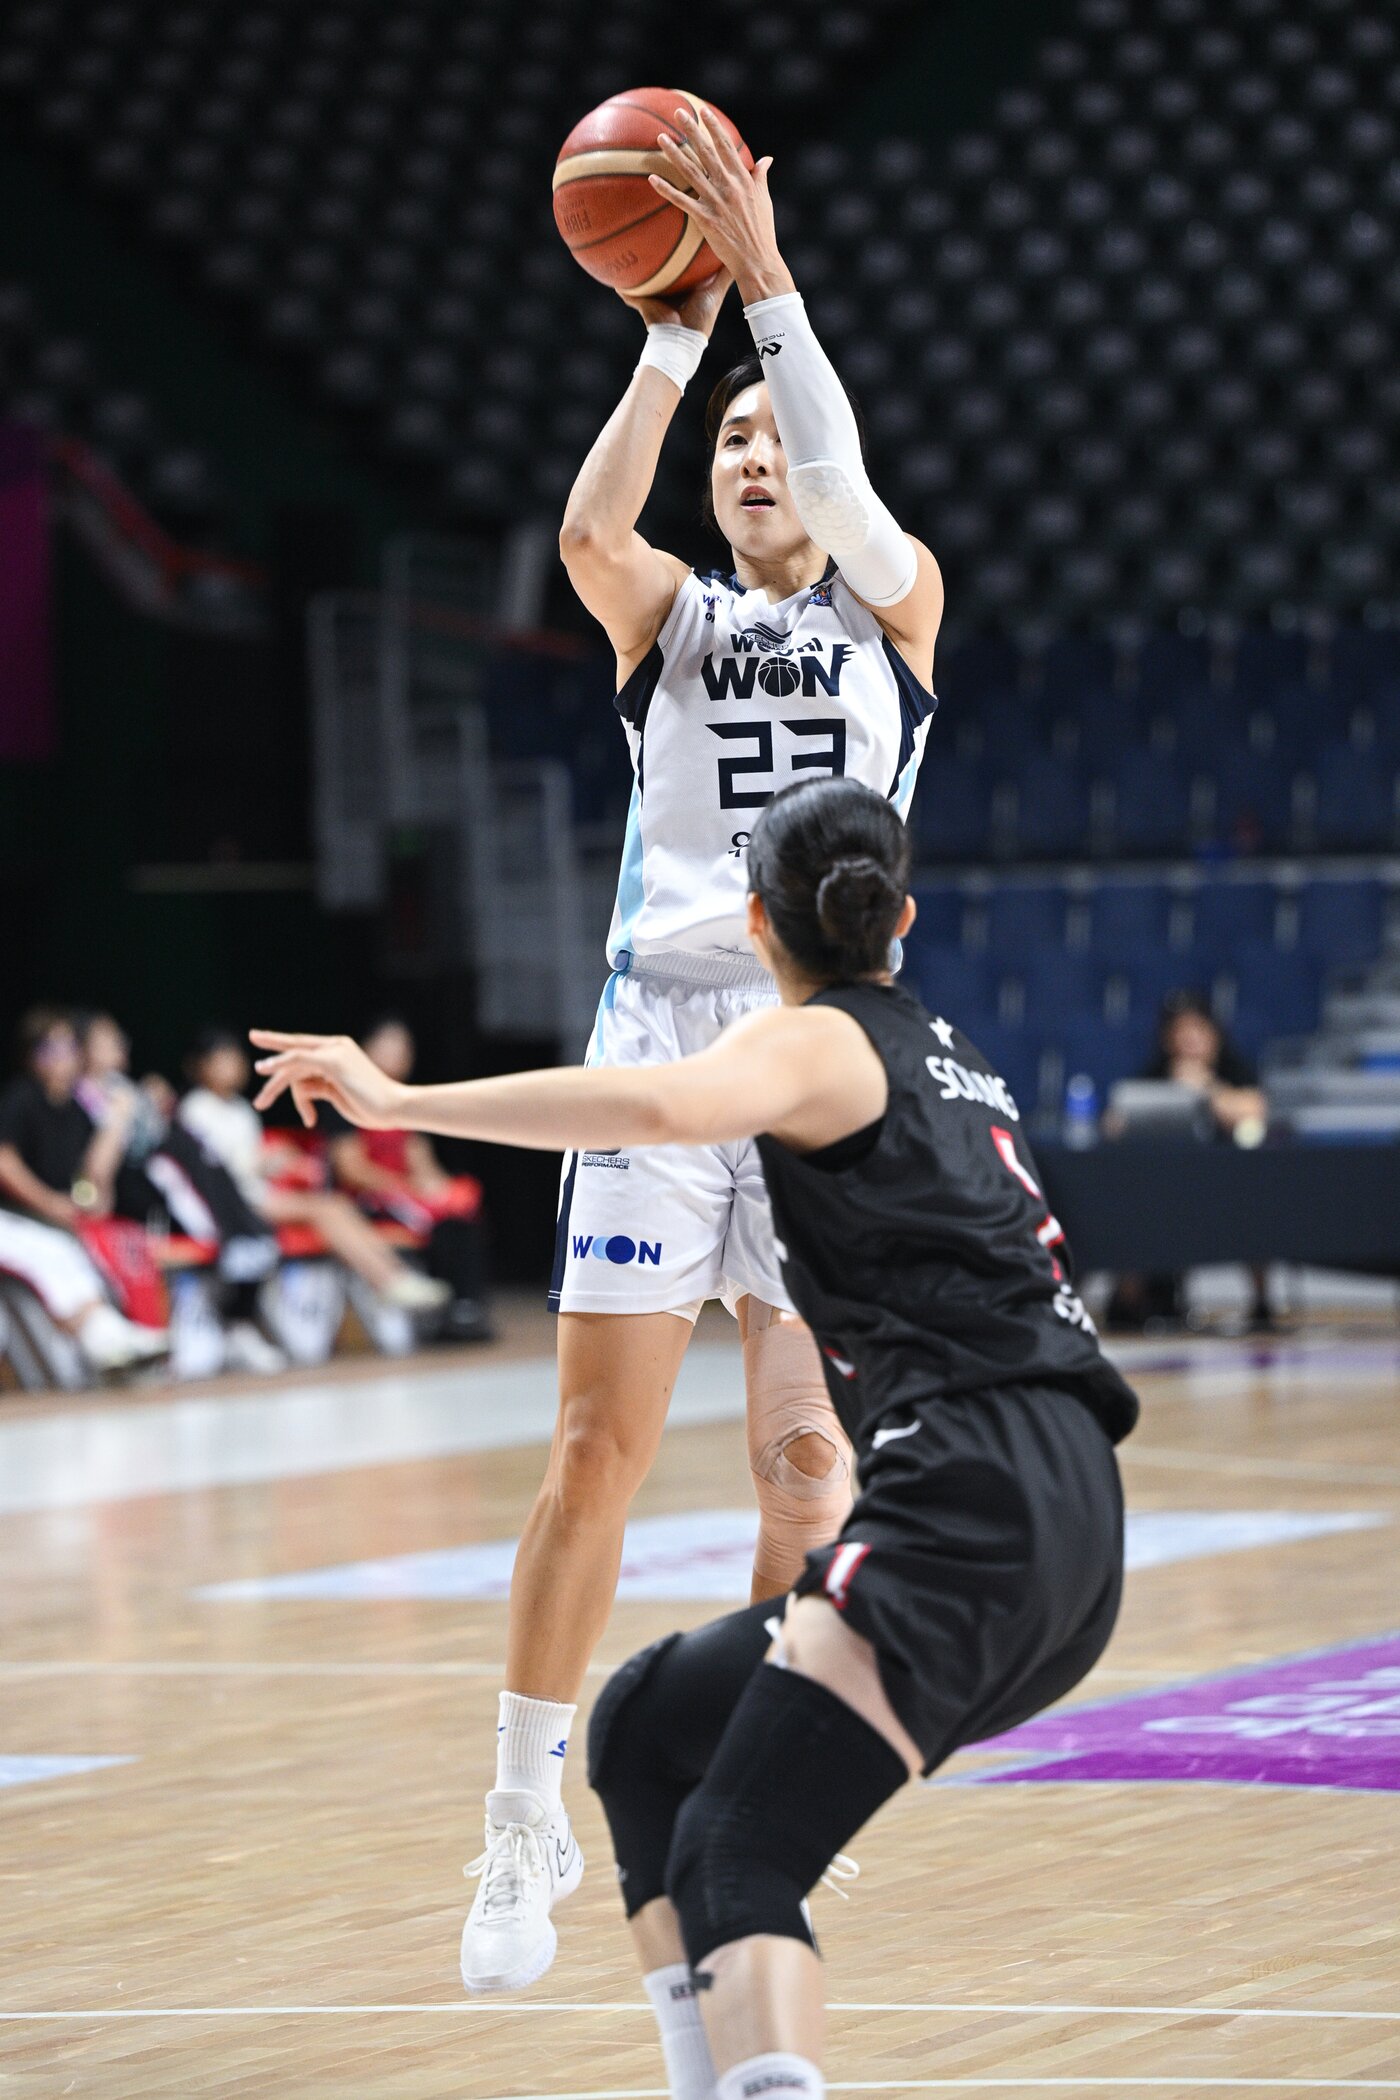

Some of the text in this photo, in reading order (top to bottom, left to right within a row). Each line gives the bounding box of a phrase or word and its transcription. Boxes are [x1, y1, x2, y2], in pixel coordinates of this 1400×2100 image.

[704, 717, 847, 810] 23
[582, 1155, 630, 1165] SKECHERS
[581, 1162, 629, 1170] PERFORMANCE
